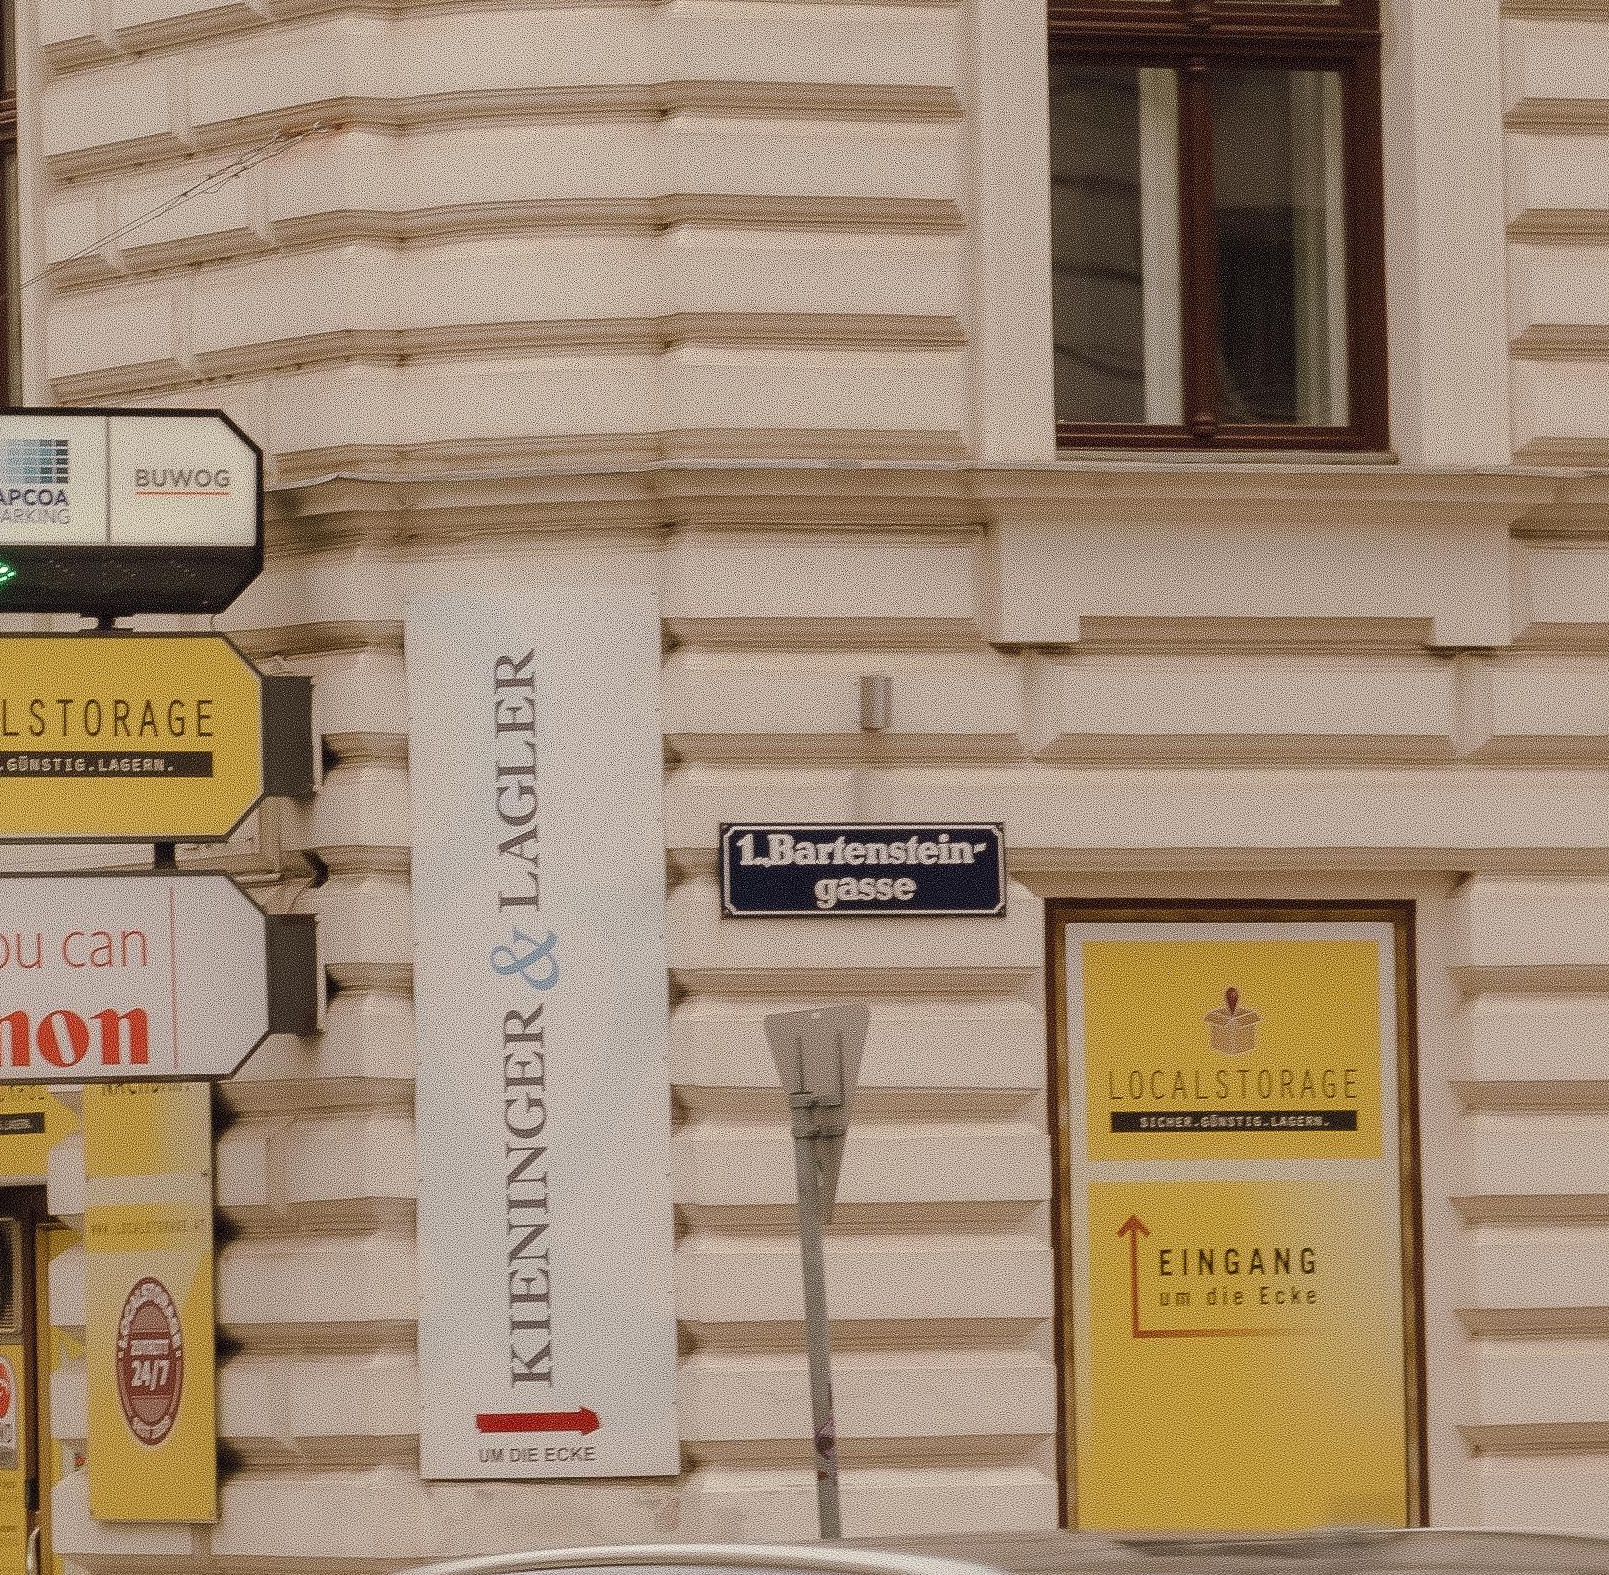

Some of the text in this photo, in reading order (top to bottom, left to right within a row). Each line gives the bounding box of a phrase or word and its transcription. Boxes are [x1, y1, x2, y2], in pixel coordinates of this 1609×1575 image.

[135, 469, 230, 488] BUWOG
[814, 877, 917, 909] gasse
[62, 930, 147, 968] can
[490, 647, 560, 1388] KIENINGER & LAGLER
[1109, 1069, 1358, 1100] LOCALSTORAGE
[1159, 1247, 1316, 1276] EINGANG
[1159, 1286, 1317, 1306] um die Ecke
[131, 1359, 170, 1391] 24/7
[478, 1446, 596, 1463] UM DIE ECKE
